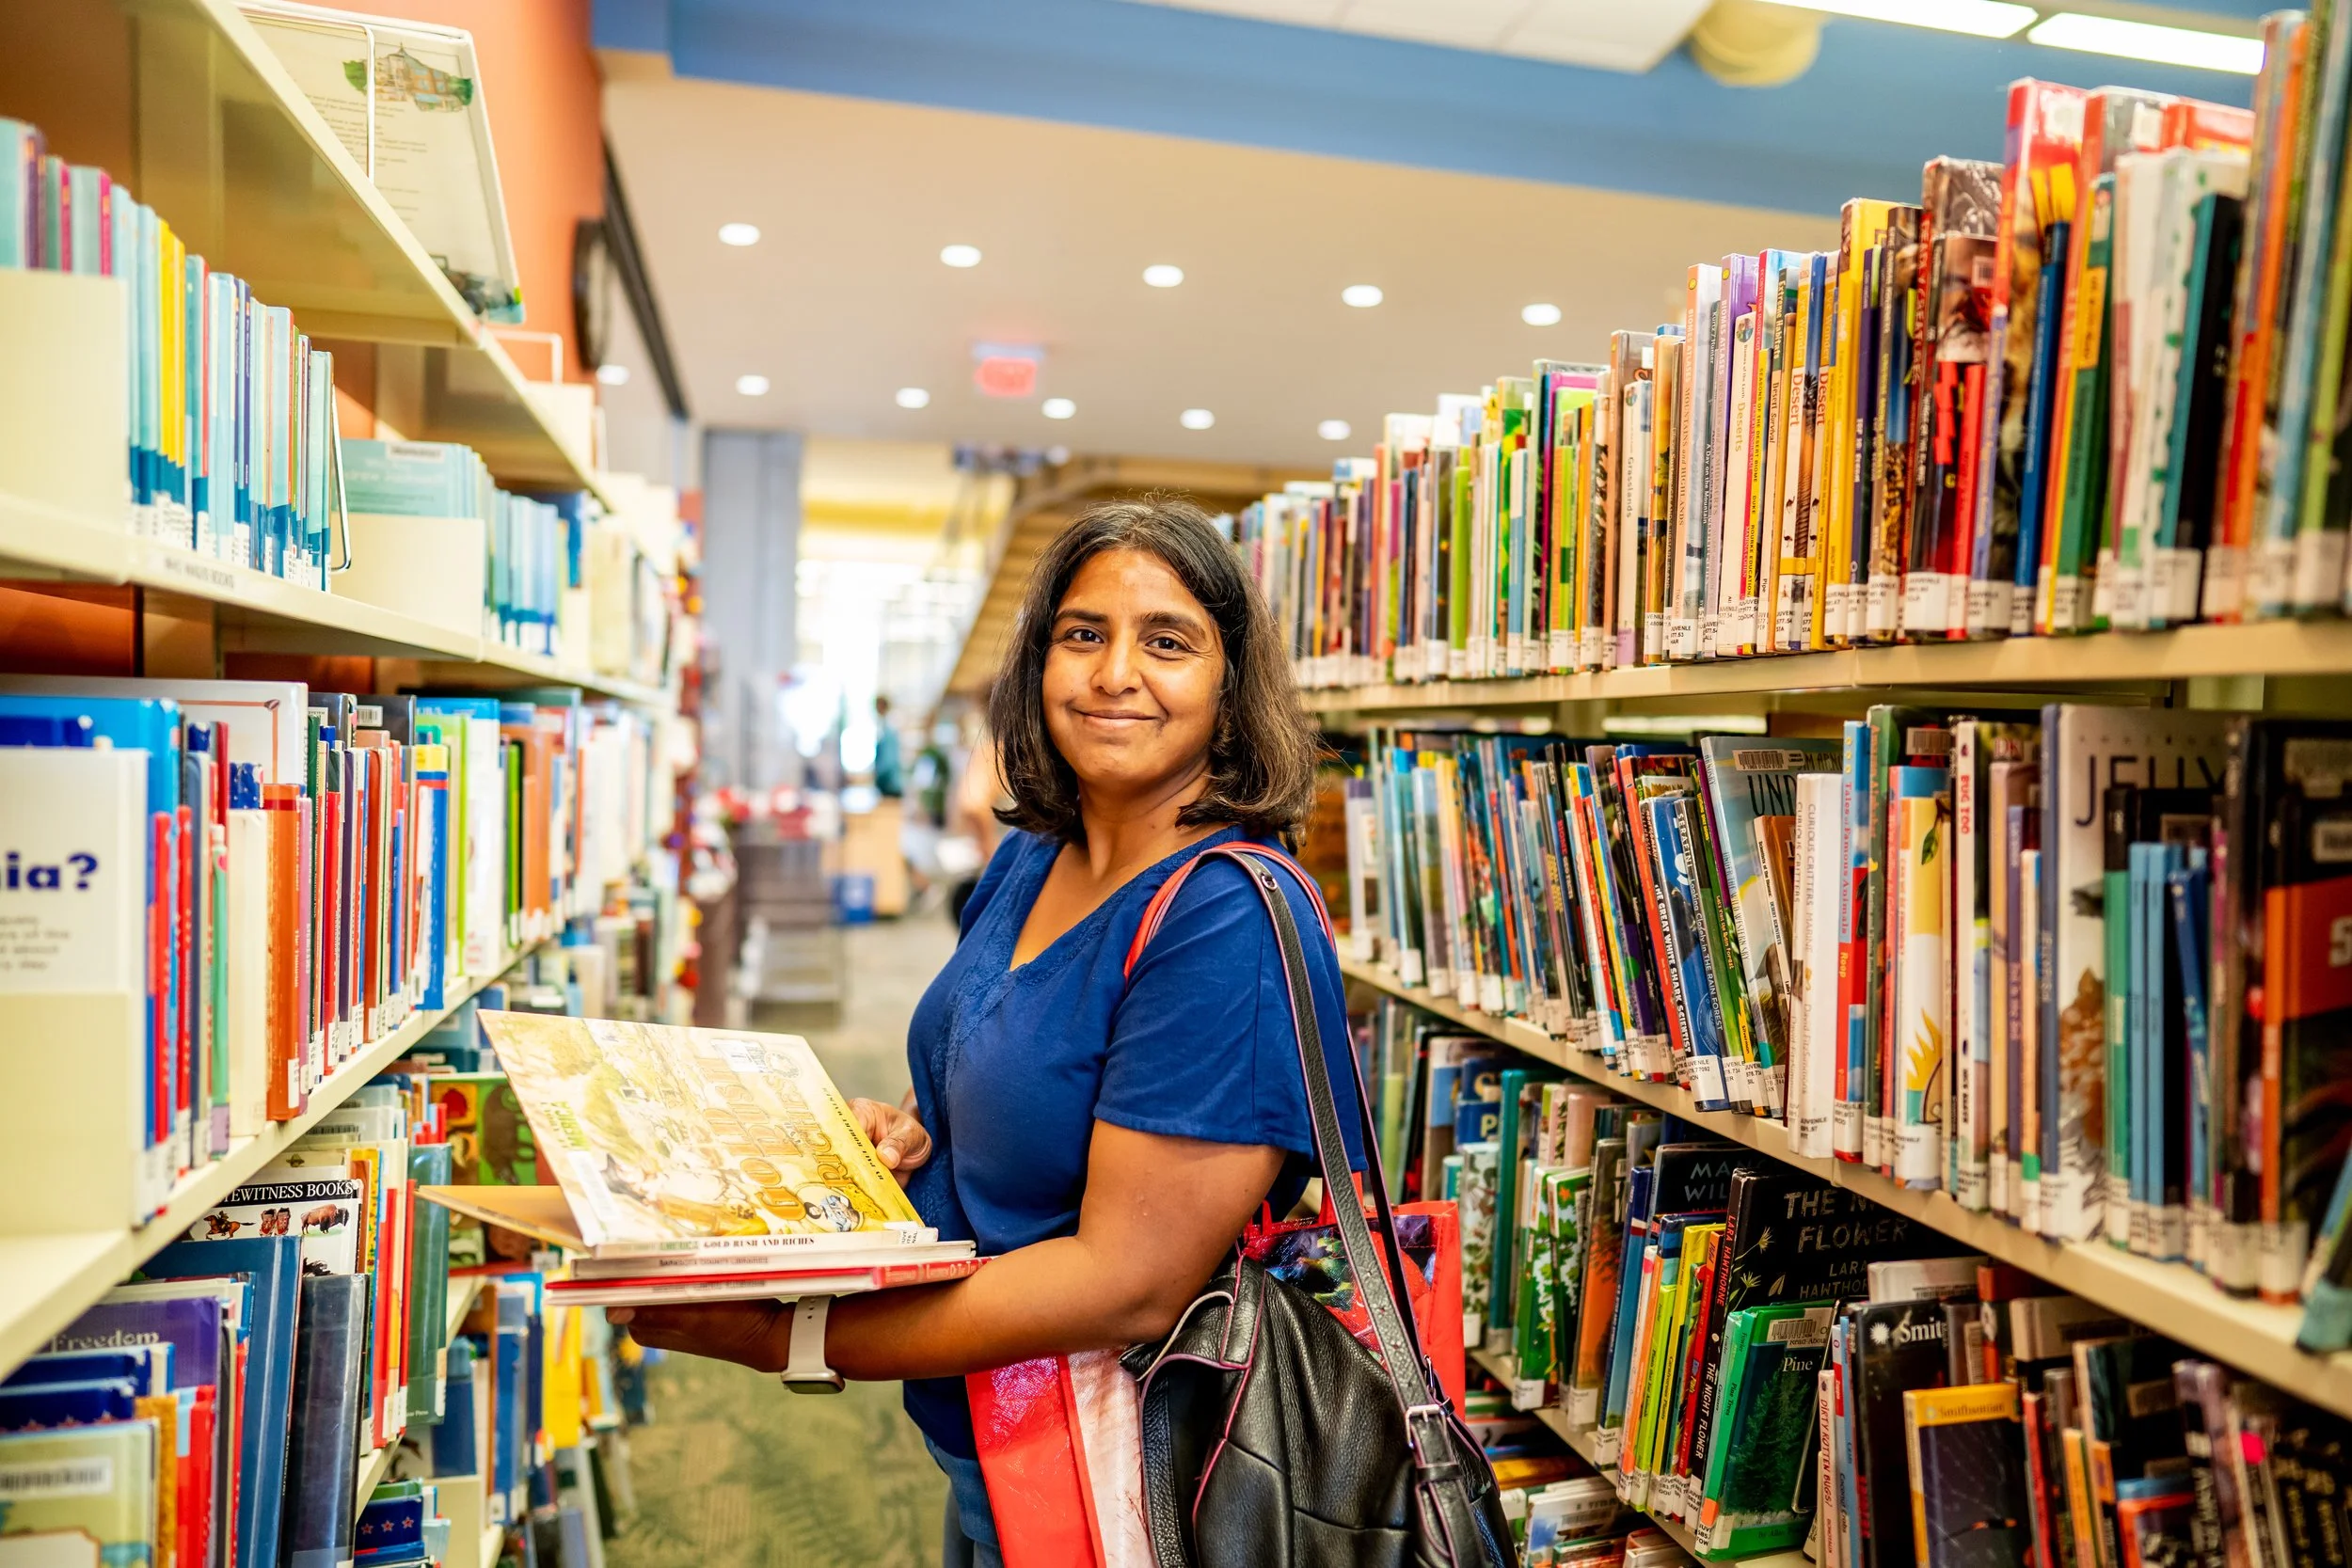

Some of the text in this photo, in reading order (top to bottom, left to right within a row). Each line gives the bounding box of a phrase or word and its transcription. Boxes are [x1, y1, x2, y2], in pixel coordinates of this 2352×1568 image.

[1773, 280, 1786, 359] Extreme Habitats
[1797, 289, 1808, 363] Eye Wonder
[1685, 346, 1693, 383] ATLASES
[1718, 337, 1726, 376] ATLASES
[1682, 387, 1691, 449] MOUNTAINS
[1769, 382, 1779, 444] Desert Survival
[1790, 373, 1804, 427] Desert
[1816, 372, 1829, 426] Desert
[1735, 402, 1747, 452] Deserts
[1626, 456, 1635, 518] Grasslands
[1678, 467, 1687, 527] HIGHLANDS
[1702, 490, 1710, 525] Mountain
[1844, 782, 1852, 816] Tales
[1677, 813, 1692, 868] SERAFINI
[1806, 802, 1817, 852] CURIOUS
[1842, 826, 1851, 876] Famous
[0, 850, 98, 892] ia?
[1805, 855, 1816, 907] CRITTERS
[1657, 902, 1670, 933] GREAT
[1840, 879, 1851, 935] Animals
[1721, 932, 1729, 947] Rain
[1734, 912, 1747, 946] WESTERN
[1664, 933, 1677, 965] WHITE
[1690, 879, 1724, 1032] Looking Closely in THE RAIN FOREST
[1724, 947, 1735, 971] Forest
[1740, 946, 1750, 960] SKY
[1837, 951, 1849, 978] Roop
[1670, 967, 1682, 1002] SHARK
[1677, 1004, 1692, 1053] SCIENTIST
[1740, 1024, 1750, 1054] Silverman
[307, 1180, 355, 1197] BOOKS
[1783, 1189, 1838, 1220] THE
[703, 1238, 730, 1248] GOLD
[733, 1237, 758, 1248] RUSH
[762, 1238, 780, 1247] AND
[783, 1236, 815, 1246] RICHES
[1796, 1220, 1910, 1255] FLOWER
[1694, 1214, 1737, 1460] LARA HAWTHORNE THE NIGHT FLOWER
[1782, 1356, 1814, 1373] Pine
[1724, 1398, 1735, 1416] Trees
[1728, 1382, 1738, 1399] Pine
[1820, 1399, 1833, 1507] DIRTY ROTTEN BUGS!
